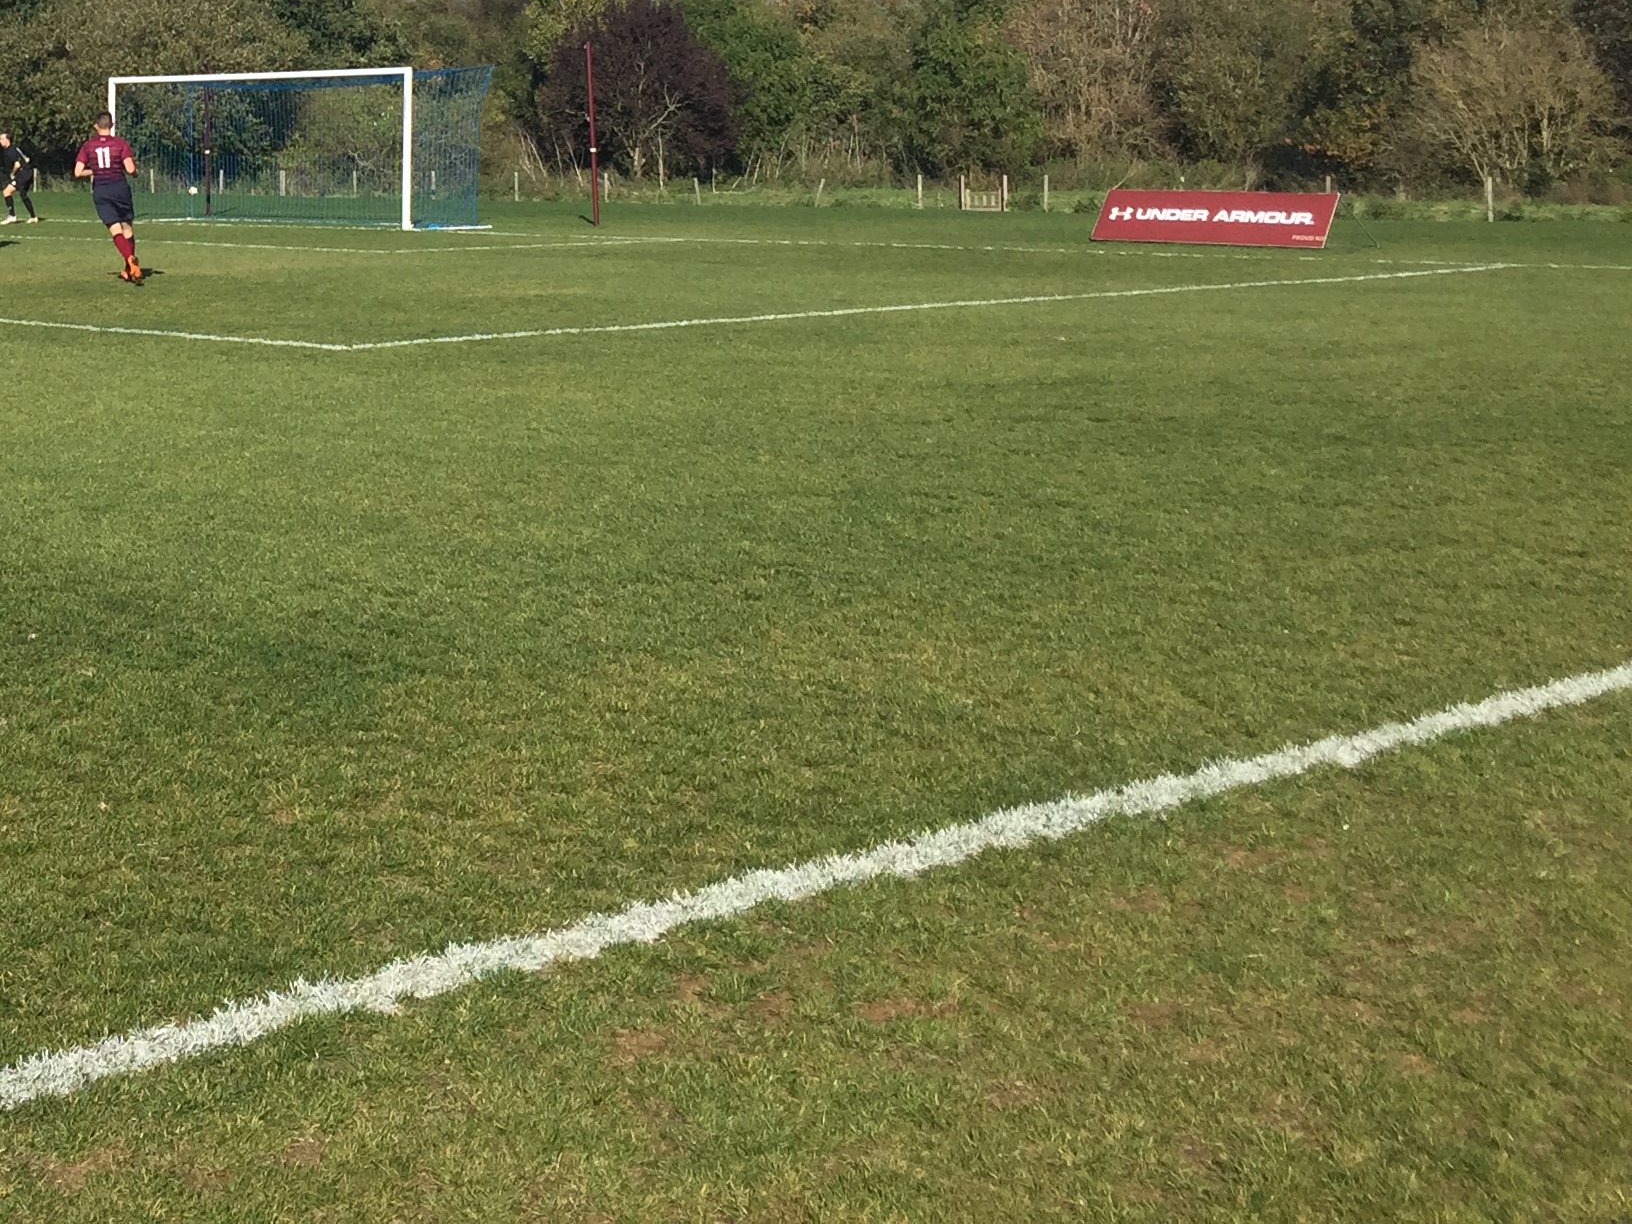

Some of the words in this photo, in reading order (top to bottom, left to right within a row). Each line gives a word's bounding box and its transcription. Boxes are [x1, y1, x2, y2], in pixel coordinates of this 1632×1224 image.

[95, 146, 111, 168] 11
[1136, 208, 1209, 222] UNDER
[1212, 209, 1314, 225] ARMOUR
